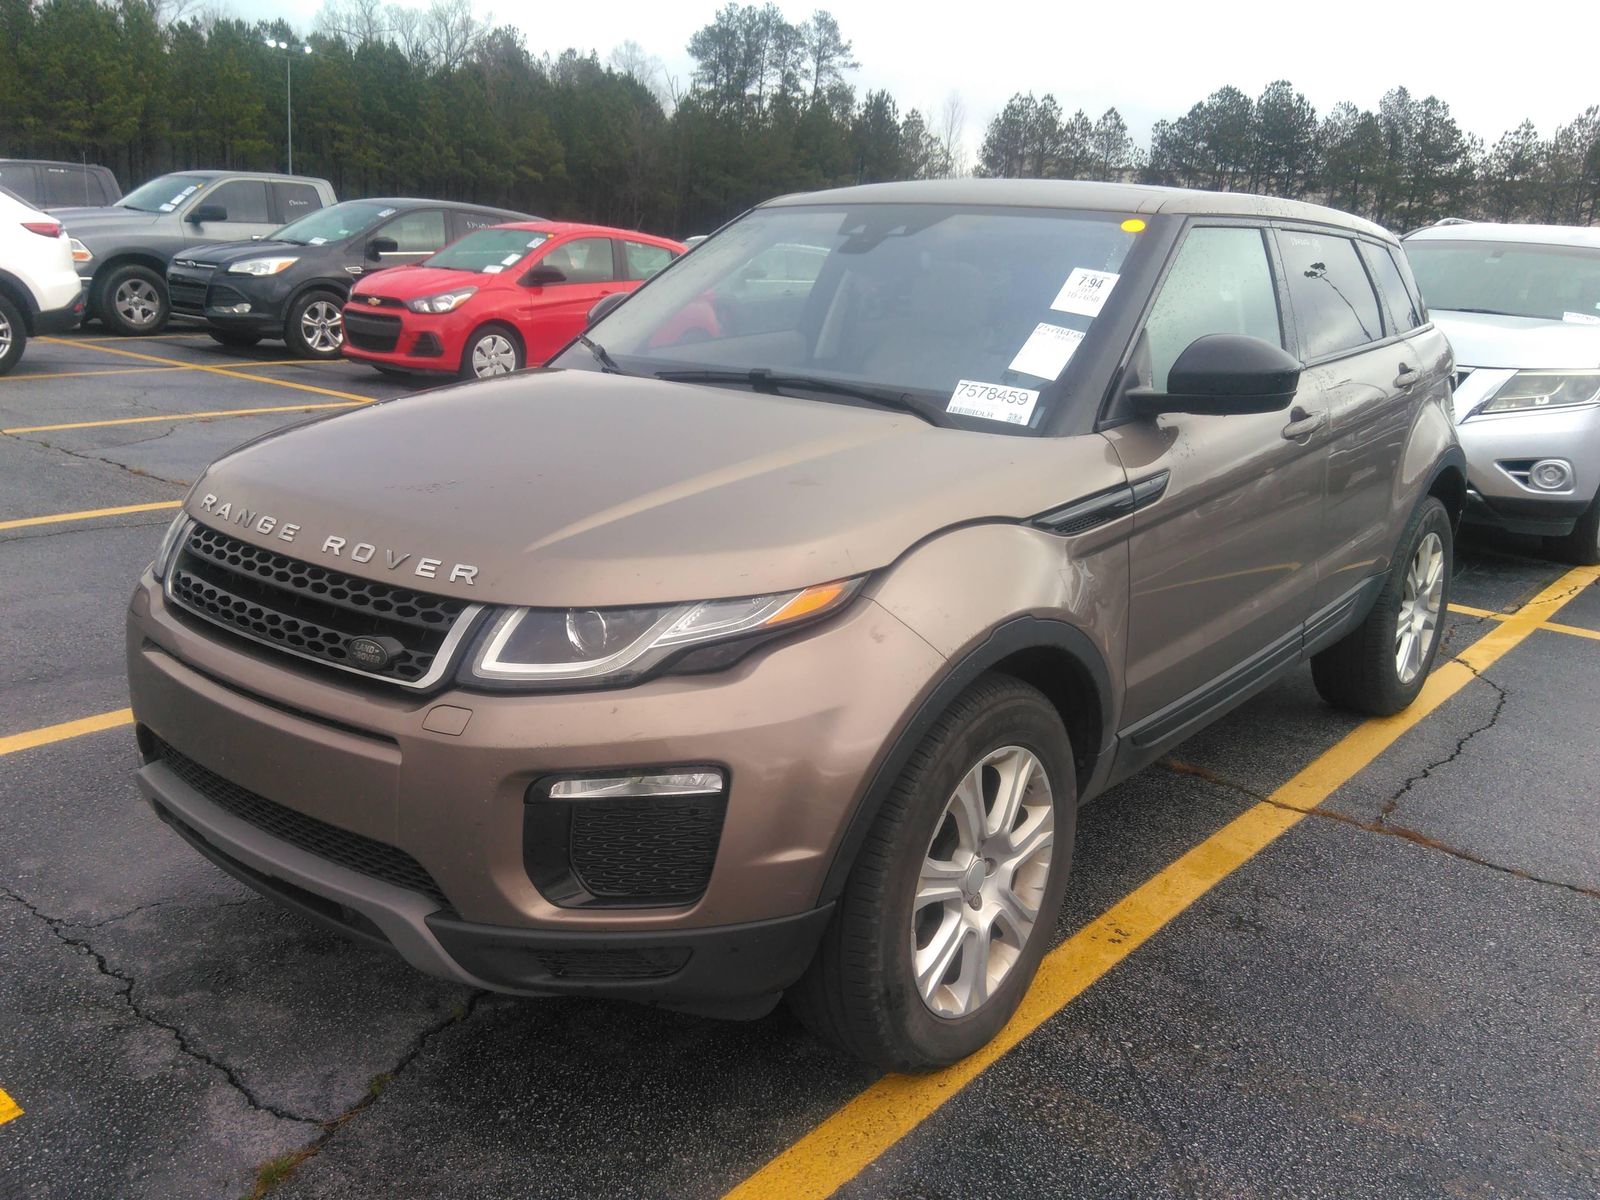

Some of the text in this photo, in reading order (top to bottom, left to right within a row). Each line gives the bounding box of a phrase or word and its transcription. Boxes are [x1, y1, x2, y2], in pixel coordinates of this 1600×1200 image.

[957, 383, 1029, 405] 7578459
[200, 493, 480, 585] RANGE ROVER
